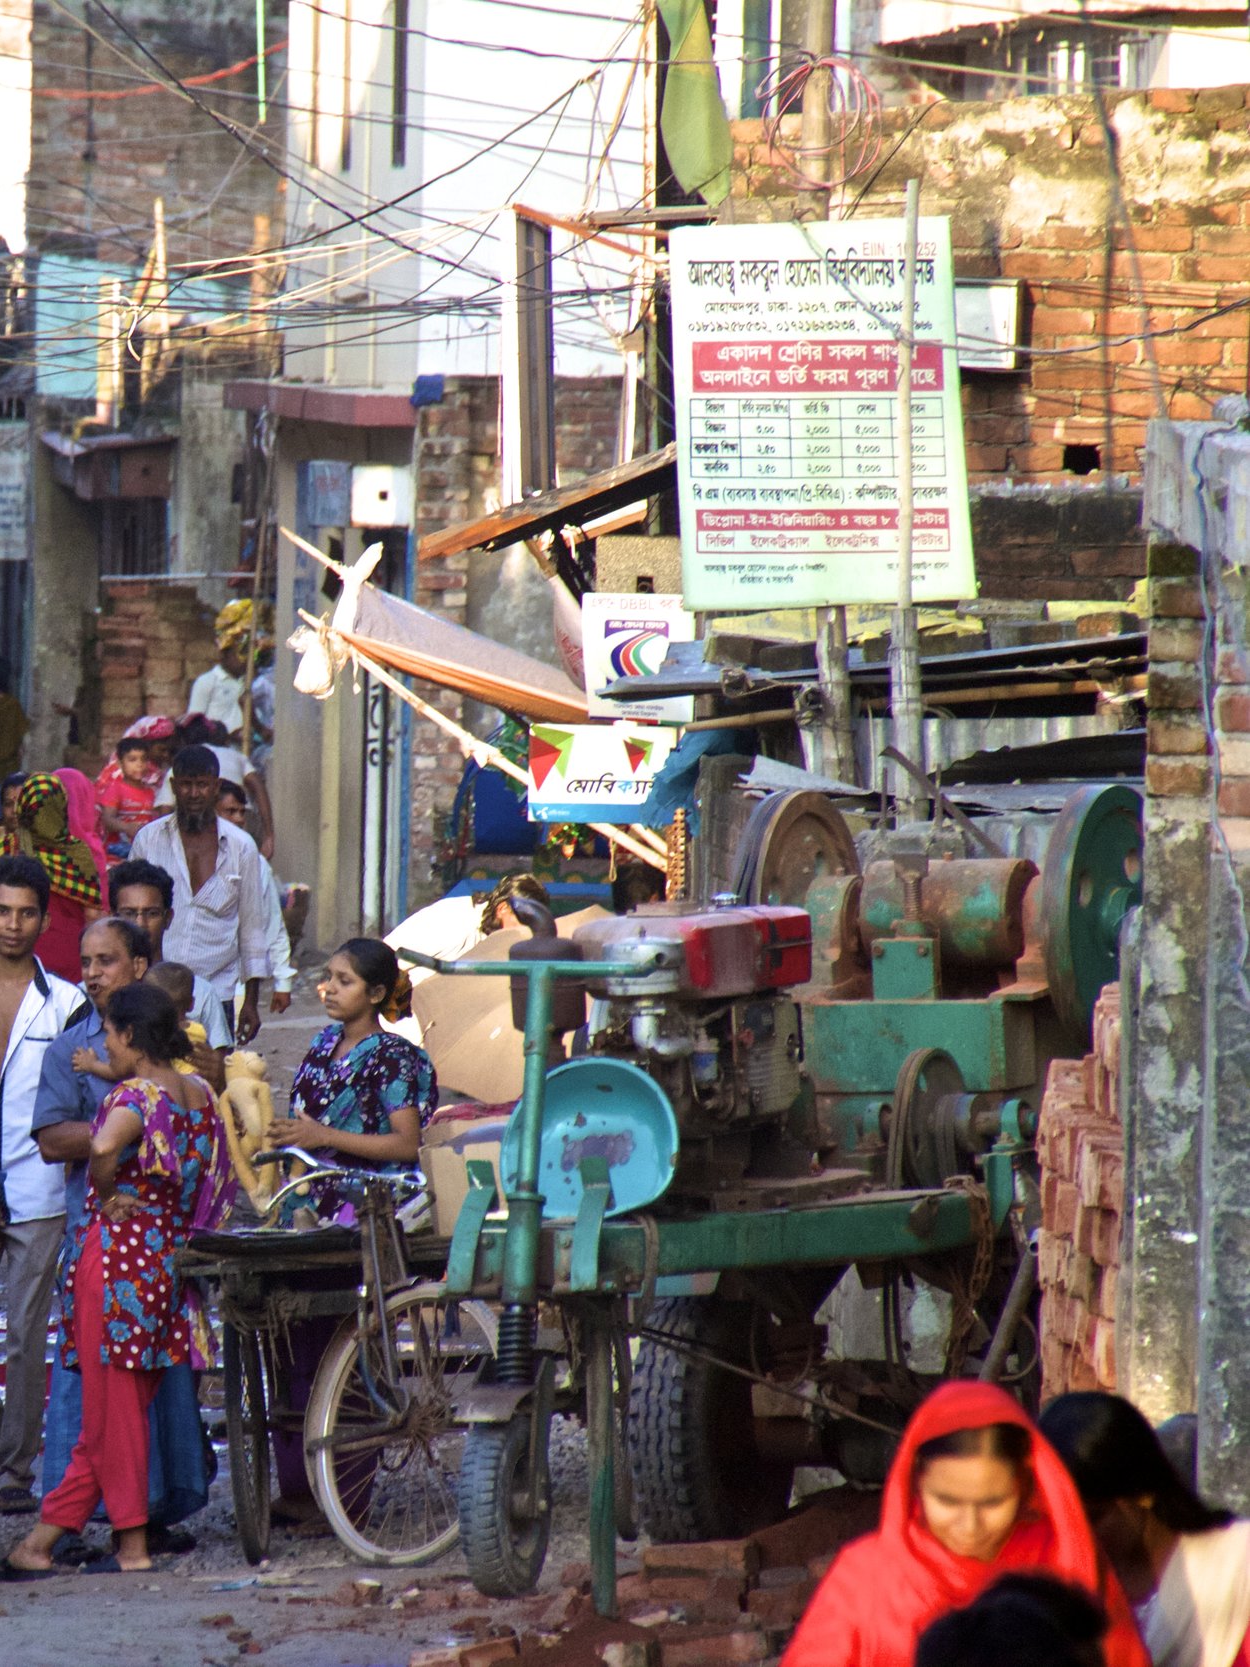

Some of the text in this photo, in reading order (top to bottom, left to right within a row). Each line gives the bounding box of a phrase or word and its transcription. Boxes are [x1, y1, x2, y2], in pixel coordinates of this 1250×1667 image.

[862, 242, 886, 256] EIIN
[896, 242, 938, 256] 1252
[739, 259, 780, 293] মকবুল
[784, 259, 822, 287] হোসেন
[898, 258, 935, 286] কলজ
[834, 301, 858, 313] ফোন
[716, 344, 773, 363] একাদশ
[778, 340, 823, 363] শ্রেণির
[827, 344, 867, 361] সকল
[699, 364, 938, 391] অনলাইনে ভর্তি ফরম পূরণ লছে
[840, 514, 849, 526] ৪
[853, 514, 878, 527] বছর
[881, 514, 891, 526] ৮
[620, 598, 655, 610] DBBL
[566, 772, 655, 795] মোবিক্যা
